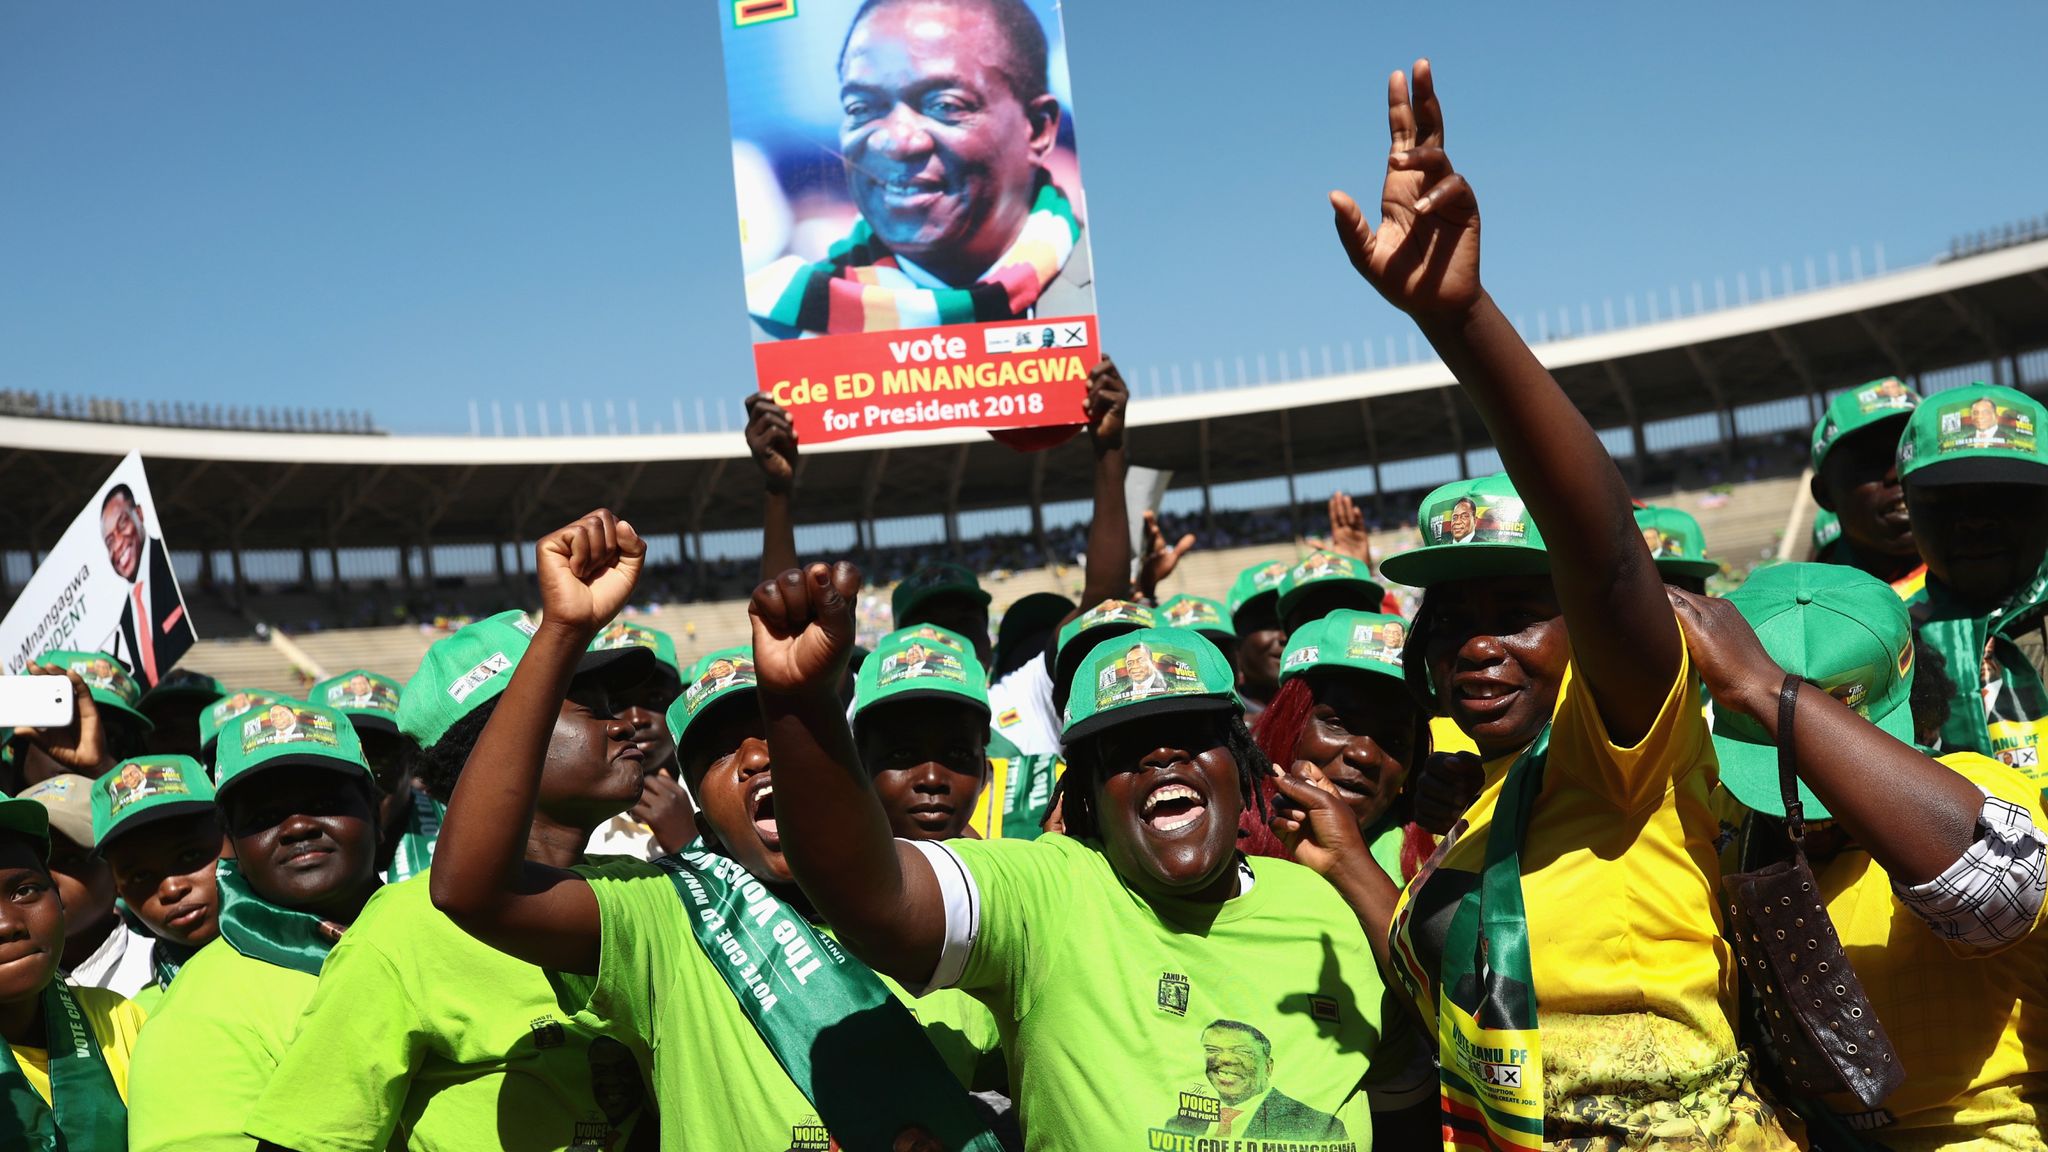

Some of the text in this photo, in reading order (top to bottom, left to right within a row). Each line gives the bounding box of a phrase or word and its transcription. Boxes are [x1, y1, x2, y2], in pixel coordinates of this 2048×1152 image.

[889, 334, 967, 363] vote
[772, 356, 1088, 407] Cde ED MNANGAGWA
[823, 393, 1044, 432] for President 2018
[8, 564, 90, 676] VaMnangagwa
[38, 594, 88, 657] SIDENT
[1993, 736, 2018, 754] ANU
[713, 858, 780, 928] Voice
[716, 928, 748, 966] CDE
[773, 920, 822, 986] The
[739, 965, 778, 1013] VOTE
[1163, 972, 1188, 983] ZANU PF
[60, 993, 81, 1019] CDE
[70, 1021, 91, 1058] VOTE
[1471, 1043, 1504, 1063] ZANU
[1510, 1049, 1528, 1064] PF
[1181, 1094, 1219, 1113] VOICE
[1187, 1082, 1207, 1095] The
[794, 1127, 829, 1142] VOICE
[1150, 1129, 1194, 1152] VOTE
[1197, 1138, 1229, 1152] CDE
